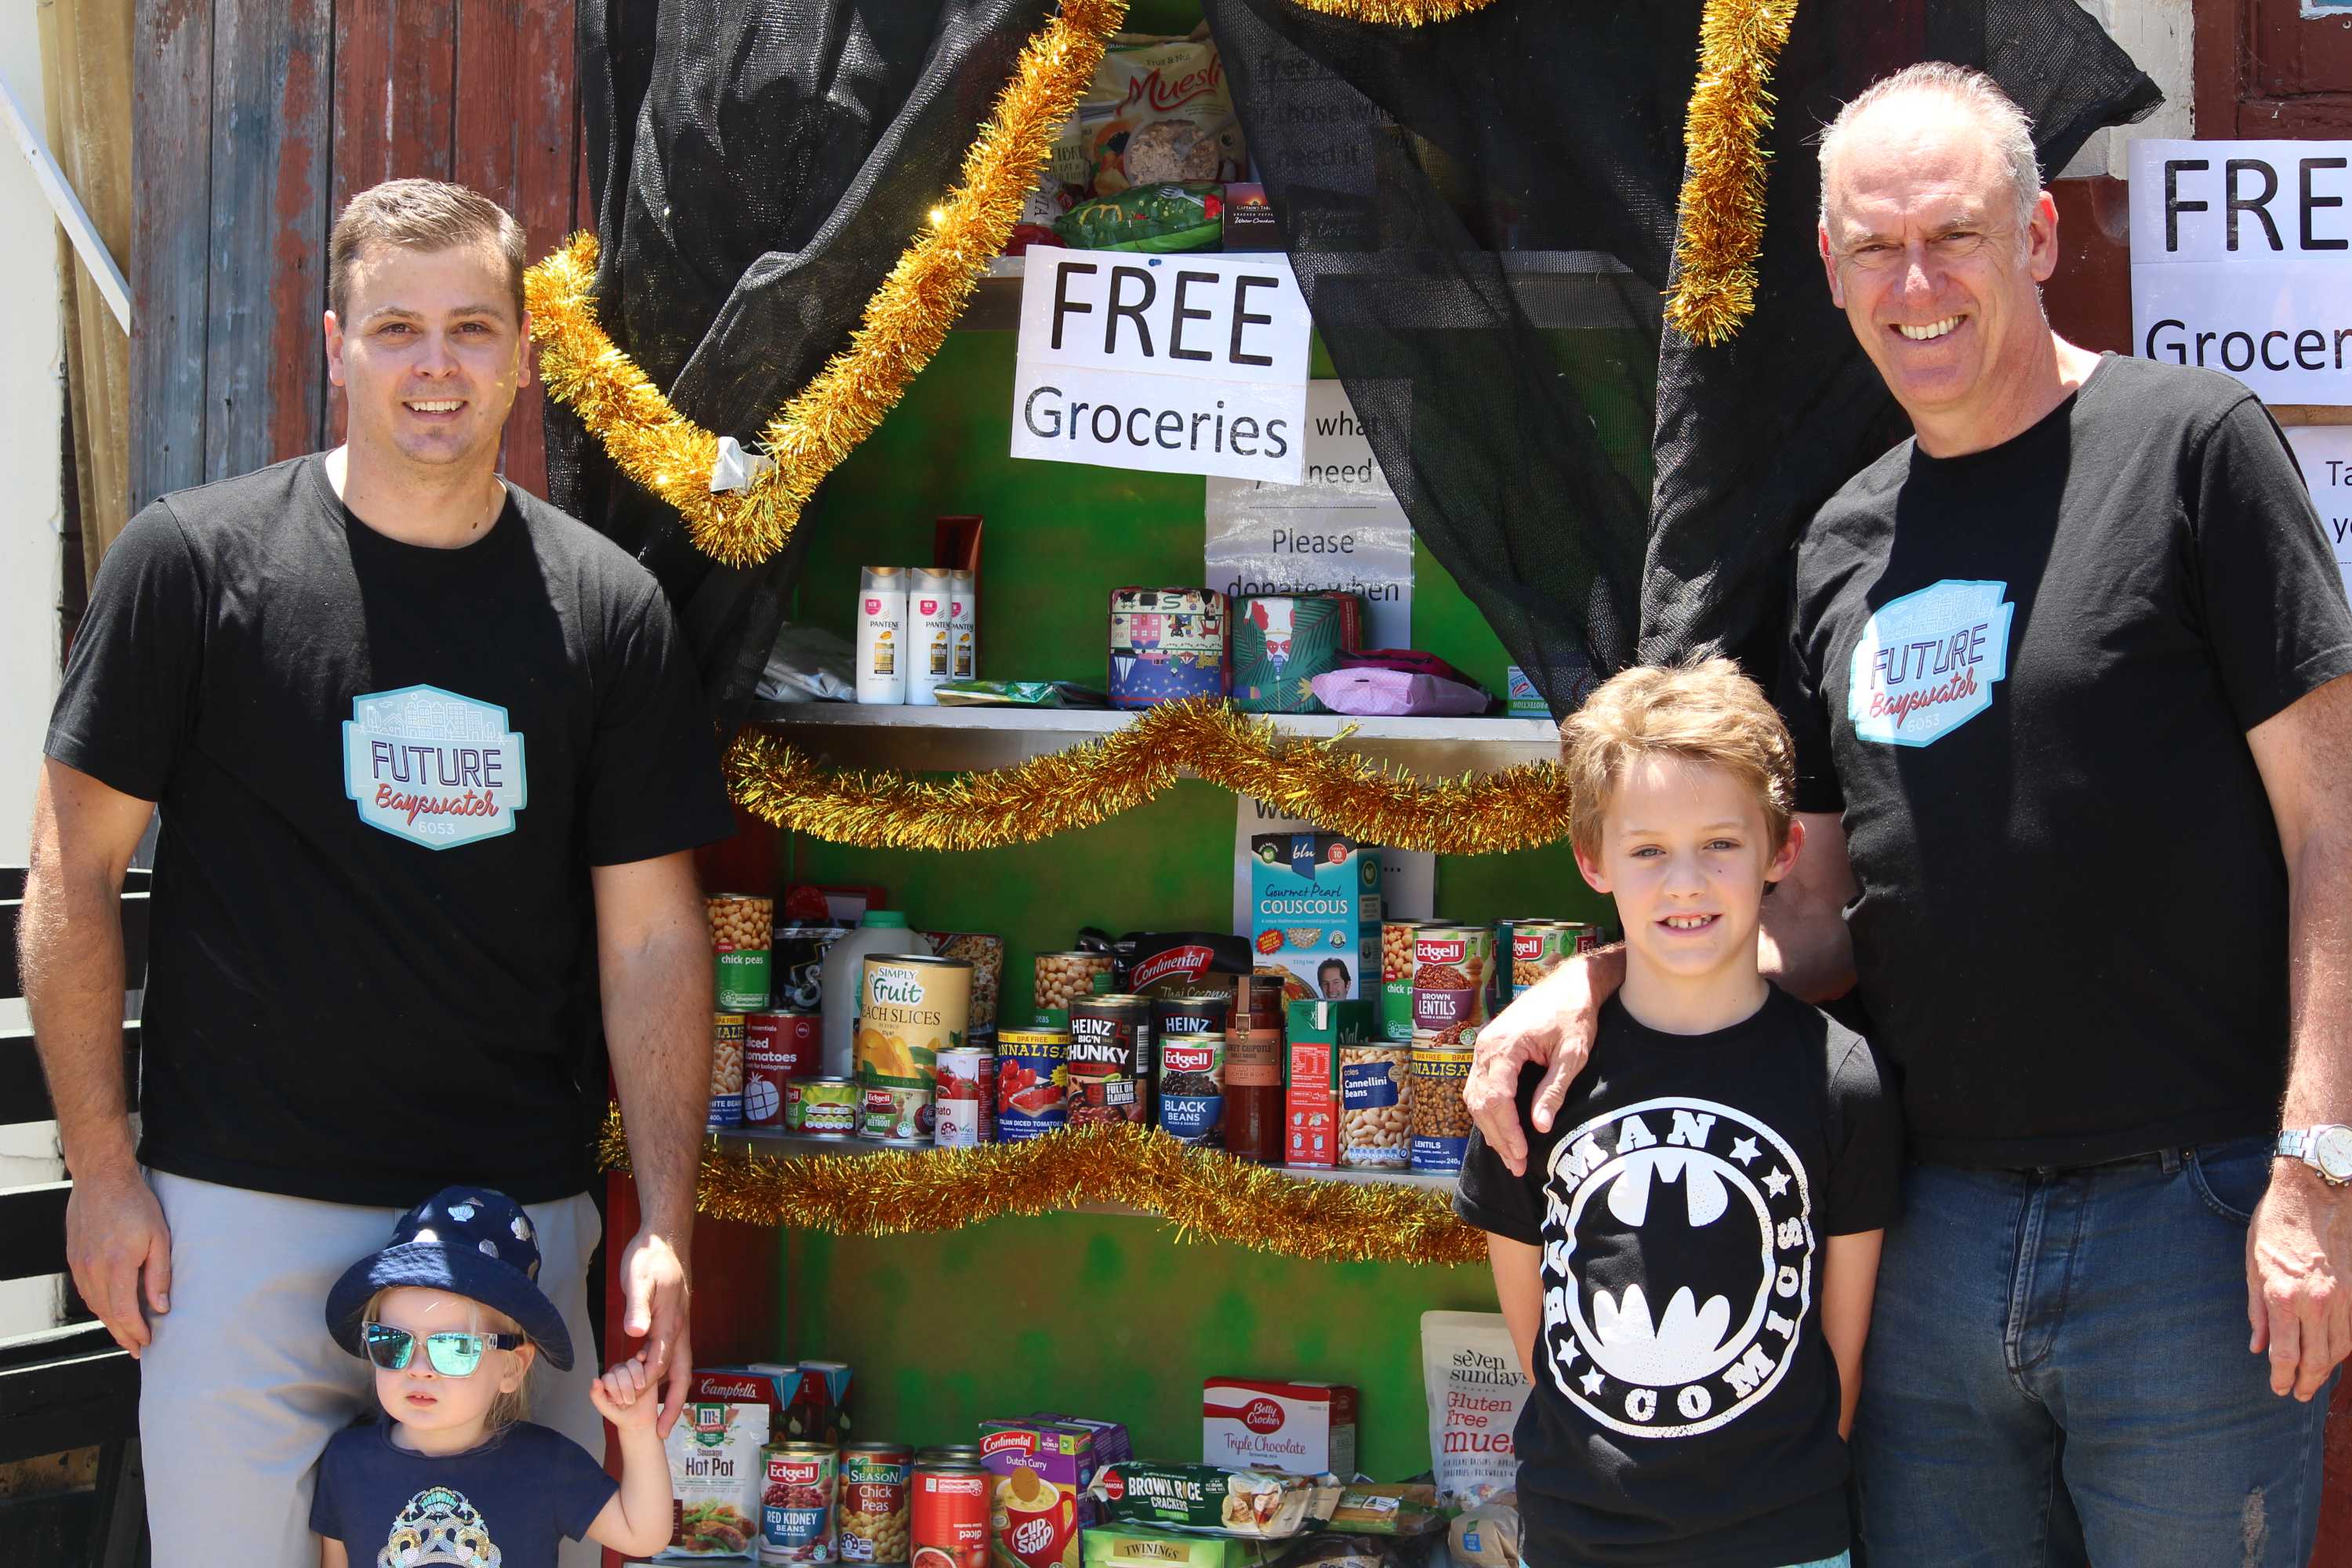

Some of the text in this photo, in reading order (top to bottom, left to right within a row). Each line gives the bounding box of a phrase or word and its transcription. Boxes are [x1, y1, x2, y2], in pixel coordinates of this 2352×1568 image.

[1116, 52, 1223, 117] Muesli
[2164, 158, 2349, 252] FRE
[1051, 261, 1279, 367] FREE
[2146, 318, 2352, 372] Grocer
[1024, 385, 1288, 459] Groceries
[1316, 410, 1374, 437] wha
[1308, 457, 1373, 484] need
[2325, 460, 2352, 487] Ta
[1272, 528, 1355, 554] Please
[1871, 623, 1989, 690] FUTURE
[1869, 666, 1978, 729] Bayswater
[1907, 713, 1941, 733] 6053
[370, 739, 503, 789] FUTURE
[375, 782, 499, 826] Bayswater
[418, 821, 456, 835] 6053
[1293, 843, 1316, 859] blu
[1265, 882, 1342, 898] Gourmet Pearl
[1260, 899, 1348, 915] COUSCOUS
[1417, 943, 1459, 961] Edgell
[1513, 938, 1537, 956] dgell
[721, 954, 764, 965] chick peas
[879, 967, 916, 980] SIMPLY
[1134, 951, 1206, 986] Continental
[1160, 985, 1185, 998] Thai
[1387, 983, 1405, 994] chick
[1419, 1000, 1456, 1015] LENTILS
[891, 1008, 941, 1025] SLICES
[1072, 1019, 1112, 1036] HEINZ
[1166, 1017, 1209, 1033] HEINZ
[1078, 1034, 1101, 1044] BIG'N
[1165, 1051, 1208, 1069] Edgell
[1413, 1062, 1468, 1076] NALISA
[1106, 1083, 1123, 1094] FULL
[1345, 1076, 1388, 1089] Cannellini
[868, 1092, 891, 1103] Edgell
[1107, 1093, 1134, 1102] FLAVOUR
[1345, 1089, 1368, 1098] Beans
[1164, 1100, 1207, 1112] BLACK
[867, 1119, 891, 1127] BEETROOT
[1167, 1112, 1200, 1122] BEANS
[1414, 1140, 1441, 1149] LENTILS
[1624, 1217, 1805, 1422] COMICS
[702, 1378, 758, 1399] Campbell's
[1254, 1402, 1277, 1417] Betty
[1447, 1391, 1512, 1412] Gluten
[1247, 1411, 1280, 1425] Crocker
[983, 1434, 1031, 1454] Continental
[1223, 1432, 1306, 1455] Triple Chocolate
[1443, 1430, 1515, 1455] mue
[697, 1448, 723, 1458] Sausage
[686, 1457, 734, 1477] Hot Pot
[1006, 1455, 1047, 1471] Dutch Curry
[770, 1465, 815, 1482] Edgell
[851, 1469, 900, 1483] SEASON
[859, 1485, 892, 1498] Chick
[1128, 1476, 1204, 1501] BROWN RICE
[862, 1501, 890, 1512] Peas
[1150, 1496, 1189, 1512] CRACKERS
[767, 1511, 818, 1526] RED KIDNEY
[776, 1525, 805, 1534] BEANS
[959, 1530, 982, 1541] diced
[1123, 1542, 1180, 1559] TWININGS
